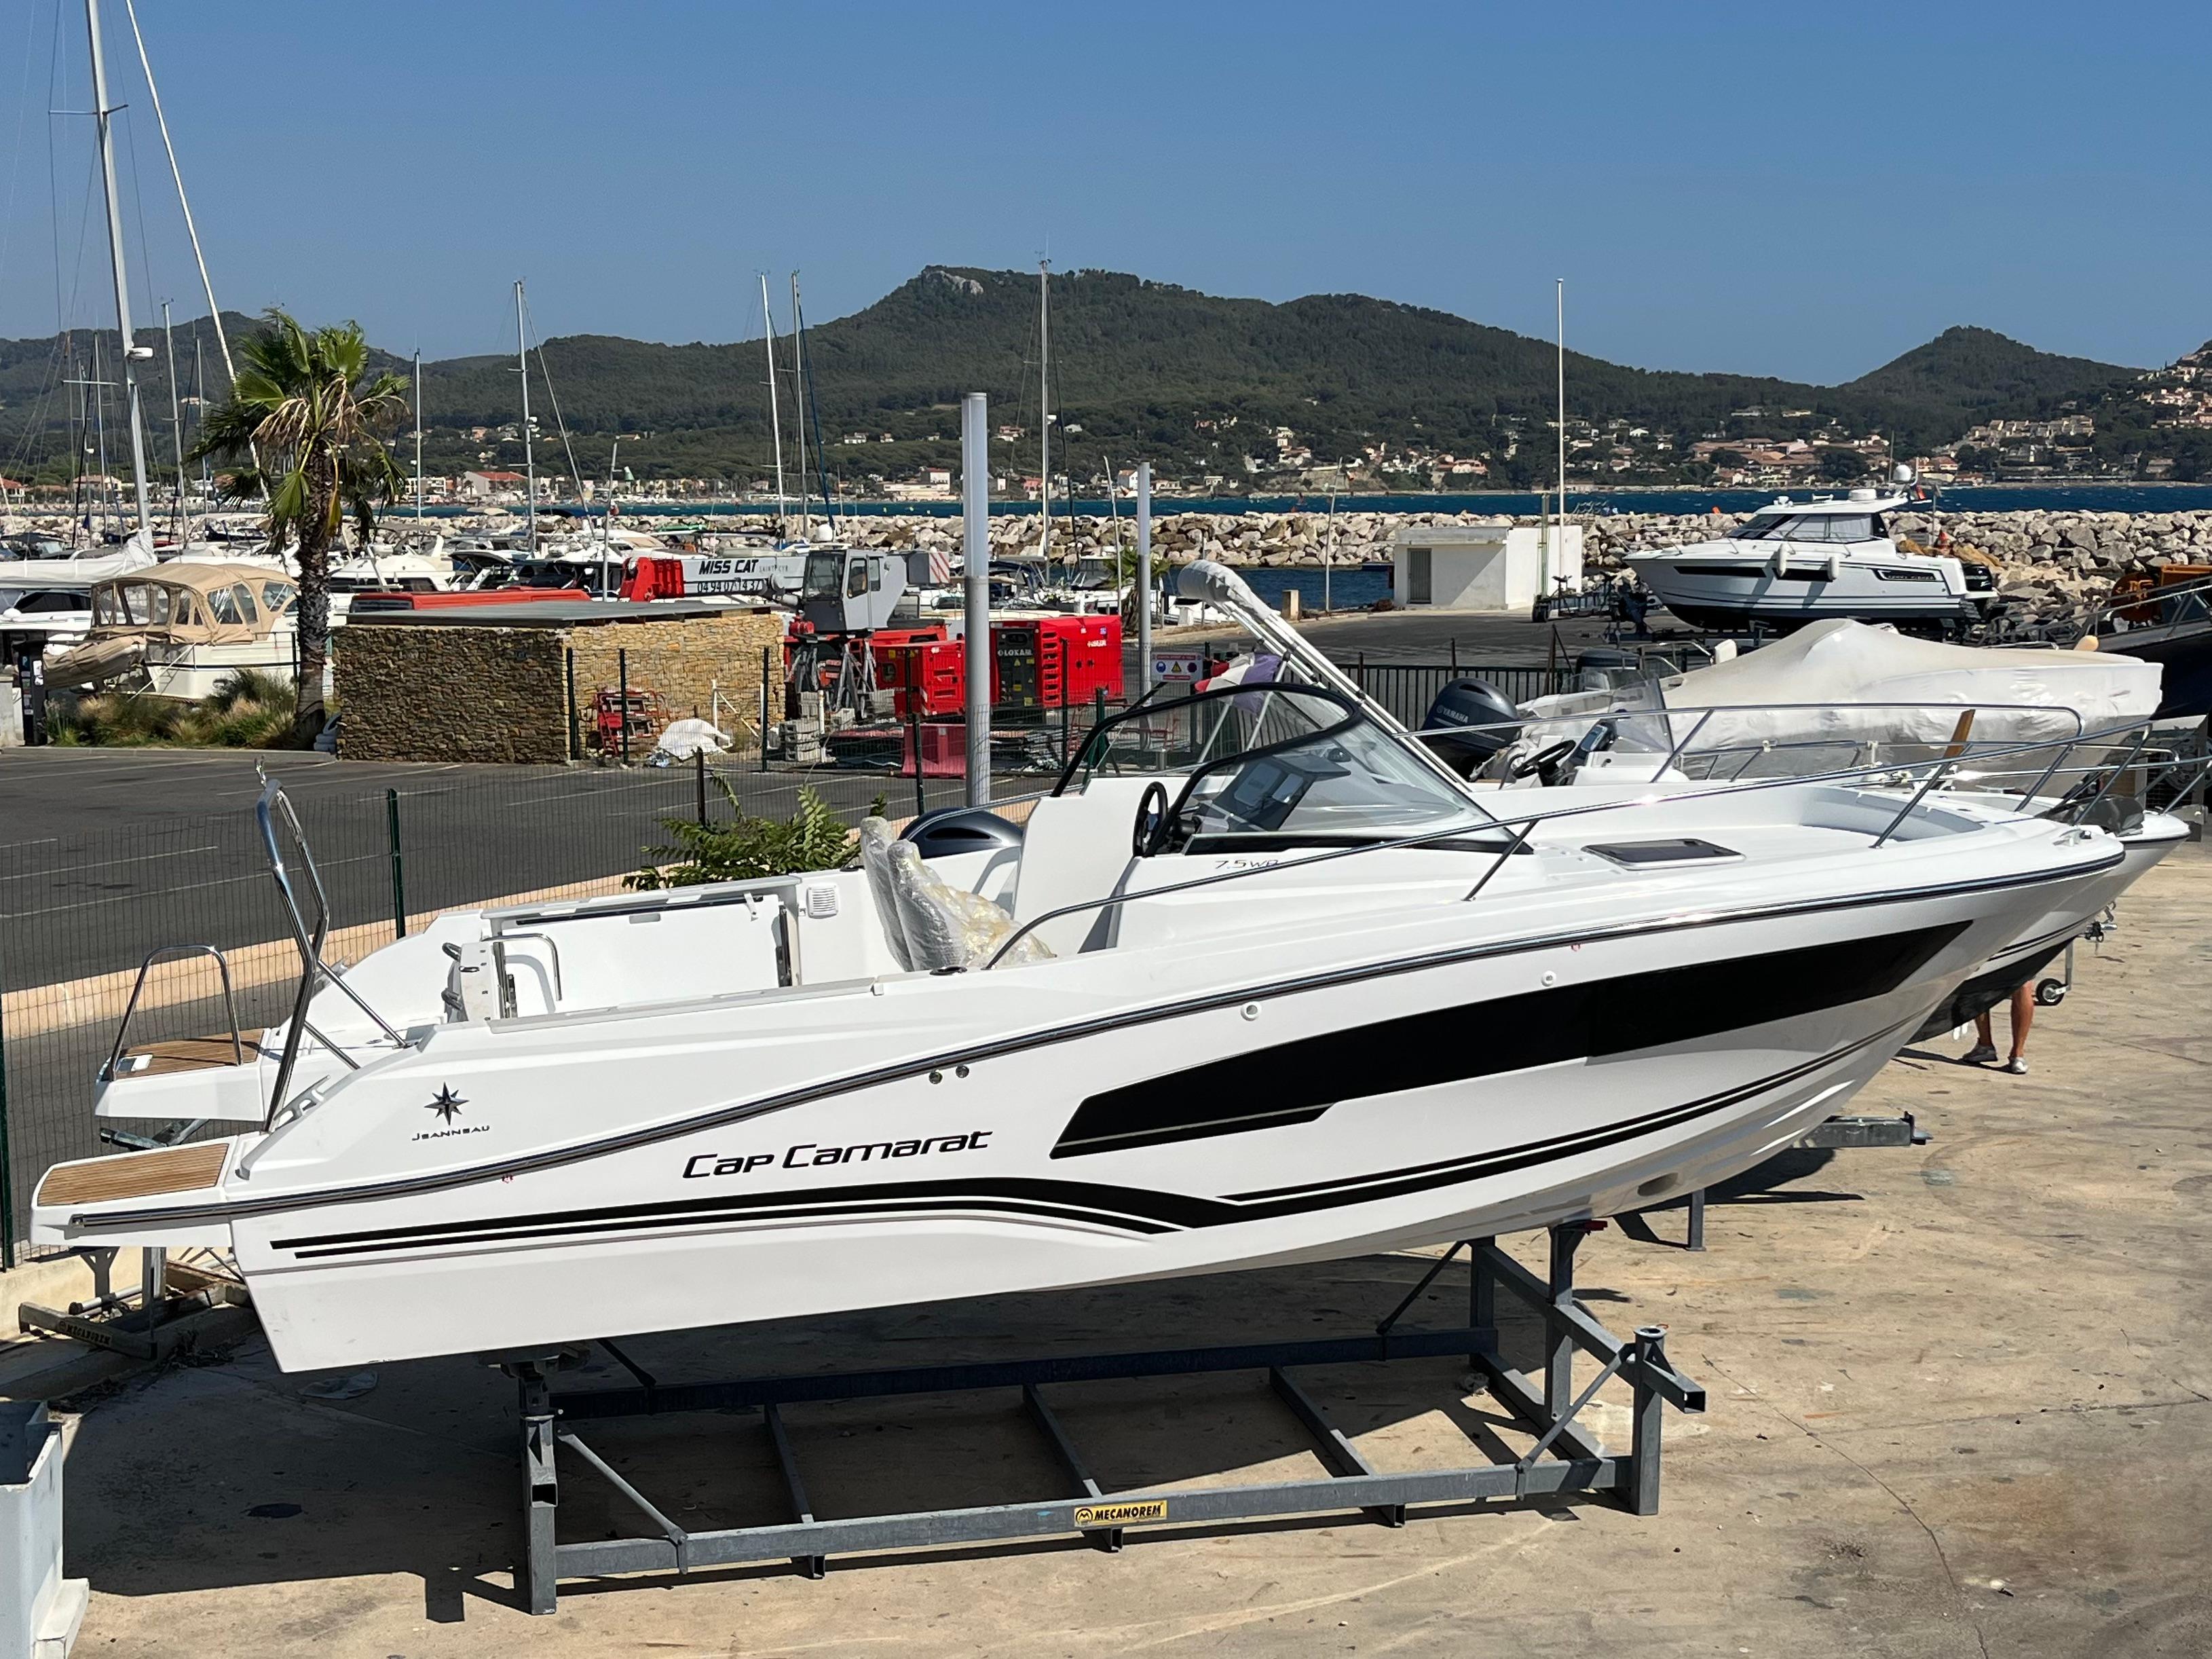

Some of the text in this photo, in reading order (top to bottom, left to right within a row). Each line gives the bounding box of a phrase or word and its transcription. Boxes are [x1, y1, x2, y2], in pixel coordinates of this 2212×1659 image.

[698, 559, 760, 575] MISS CAT
[1442, 707, 1469, 724] YAMAHA
[411, 1124, 490, 1141] JEANNEAU
[682, 1131, 993, 1178] Cap Camarat
[1093, 1504, 1162, 1521] MECANOREM
